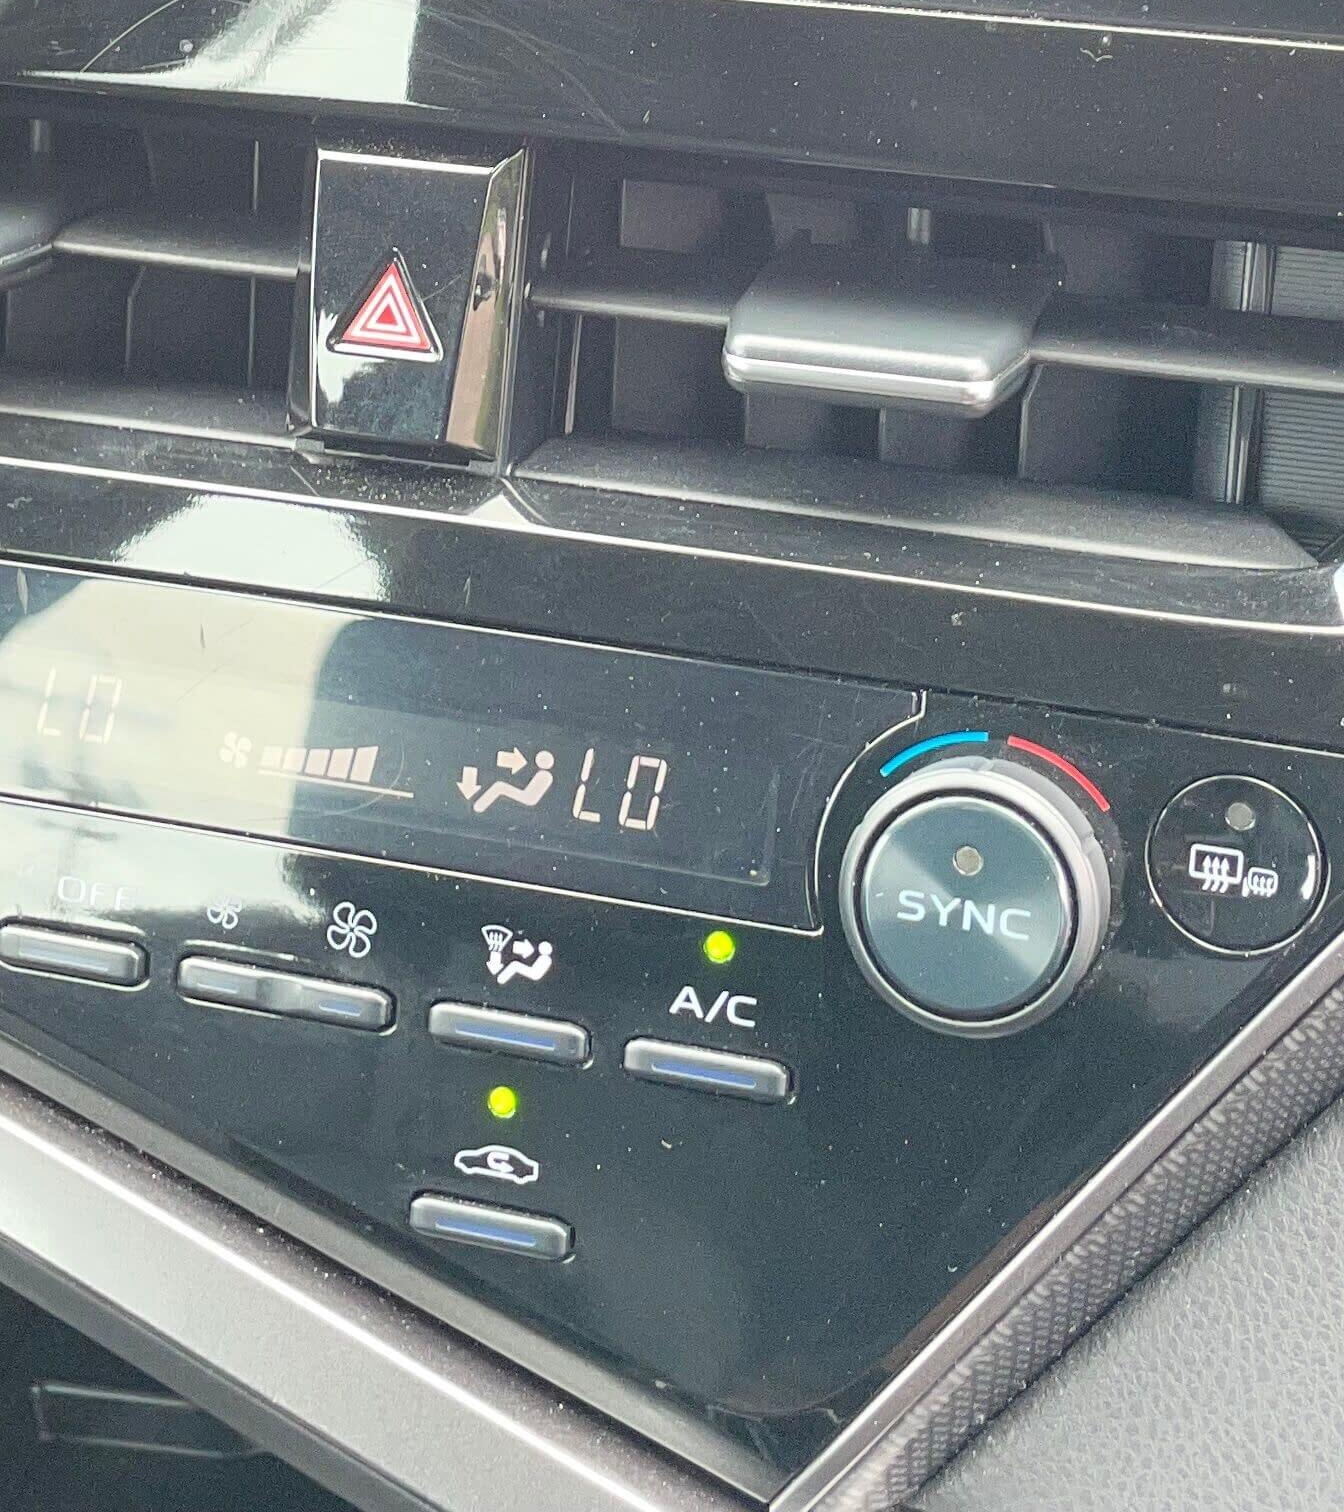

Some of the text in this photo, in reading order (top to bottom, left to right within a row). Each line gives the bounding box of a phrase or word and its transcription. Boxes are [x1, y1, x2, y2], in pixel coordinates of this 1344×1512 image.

[57, 875, 131, 911] OFF
[896, 890, 1032, 940] SYNC
[669, 986, 757, 1027] A/C
